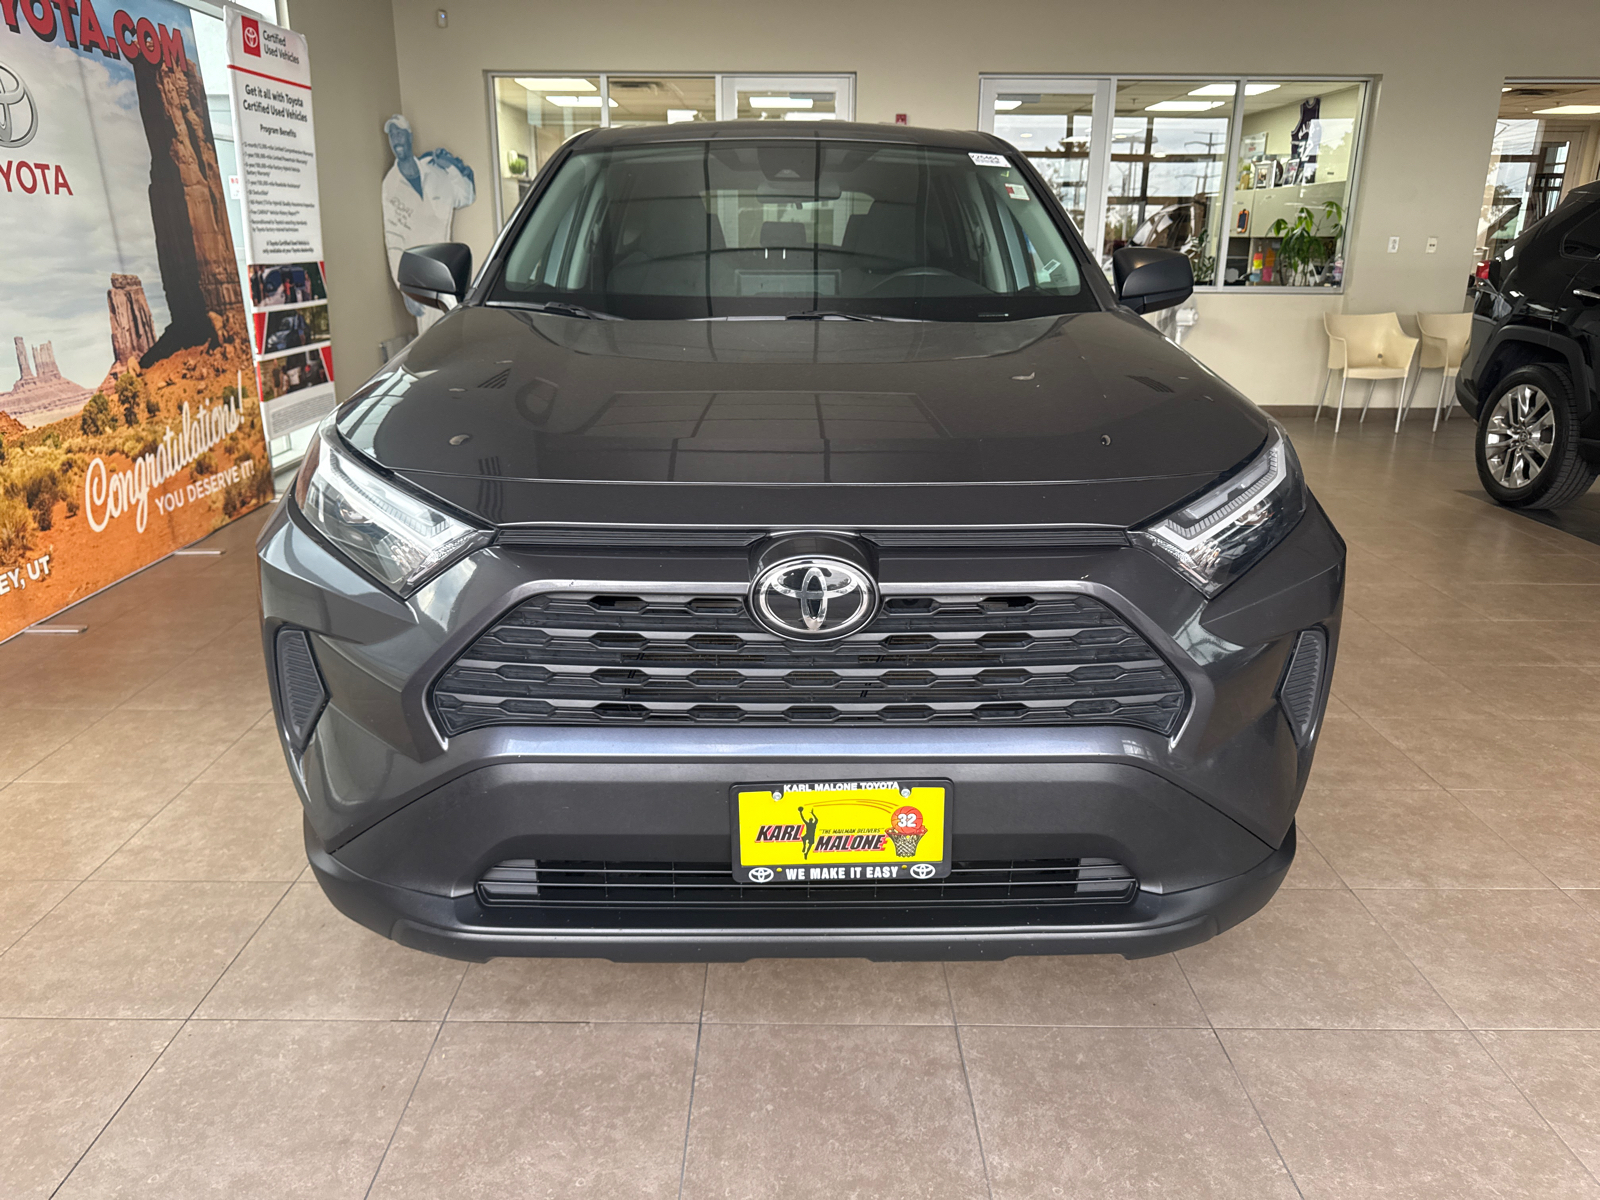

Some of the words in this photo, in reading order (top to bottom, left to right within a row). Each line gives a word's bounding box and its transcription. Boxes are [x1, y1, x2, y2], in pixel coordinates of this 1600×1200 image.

[263, 29, 286, 47] Certified
[264, 44, 278, 57] Used
[279, 48, 300, 64] Vehicles
[245, 84, 258, 97] Get
[257, 86, 263, 99] it
[263, 88, 271, 100] all
[272, 91, 285, 103] with
[285, 93, 303, 108] Toyota
[243, 99, 270, 115] Certified
[270, 105, 285, 118] Used
[286, 107, 308, 123] Vehicles
[260, 123, 279, 136] Program
[279, 127, 297, 138] Benefits
[0, 160, 74, 196] YOTA
[85, 369, 246, 534] Congratulations!
[155, 488, 185, 516] YOU
[186, 465, 241, 503] DESERVE
[240, 459, 256, 480] IT!
[26, 554, 50, 580] UT
[783, 784, 812, 793] KARL
[814, 782, 858, 792] MALONE
[860, 781, 899, 790] TOYOTA
[897, 813, 917, 828] 32
[755, 824, 805, 843] KARL
[813, 834, 888, 853] MALONE
[785, 867, 806, 880] WE
[809, 867, 846, 879] MAKE
[850, 867, 862, 879] IT
[865, 866, 899, 879] EASY
